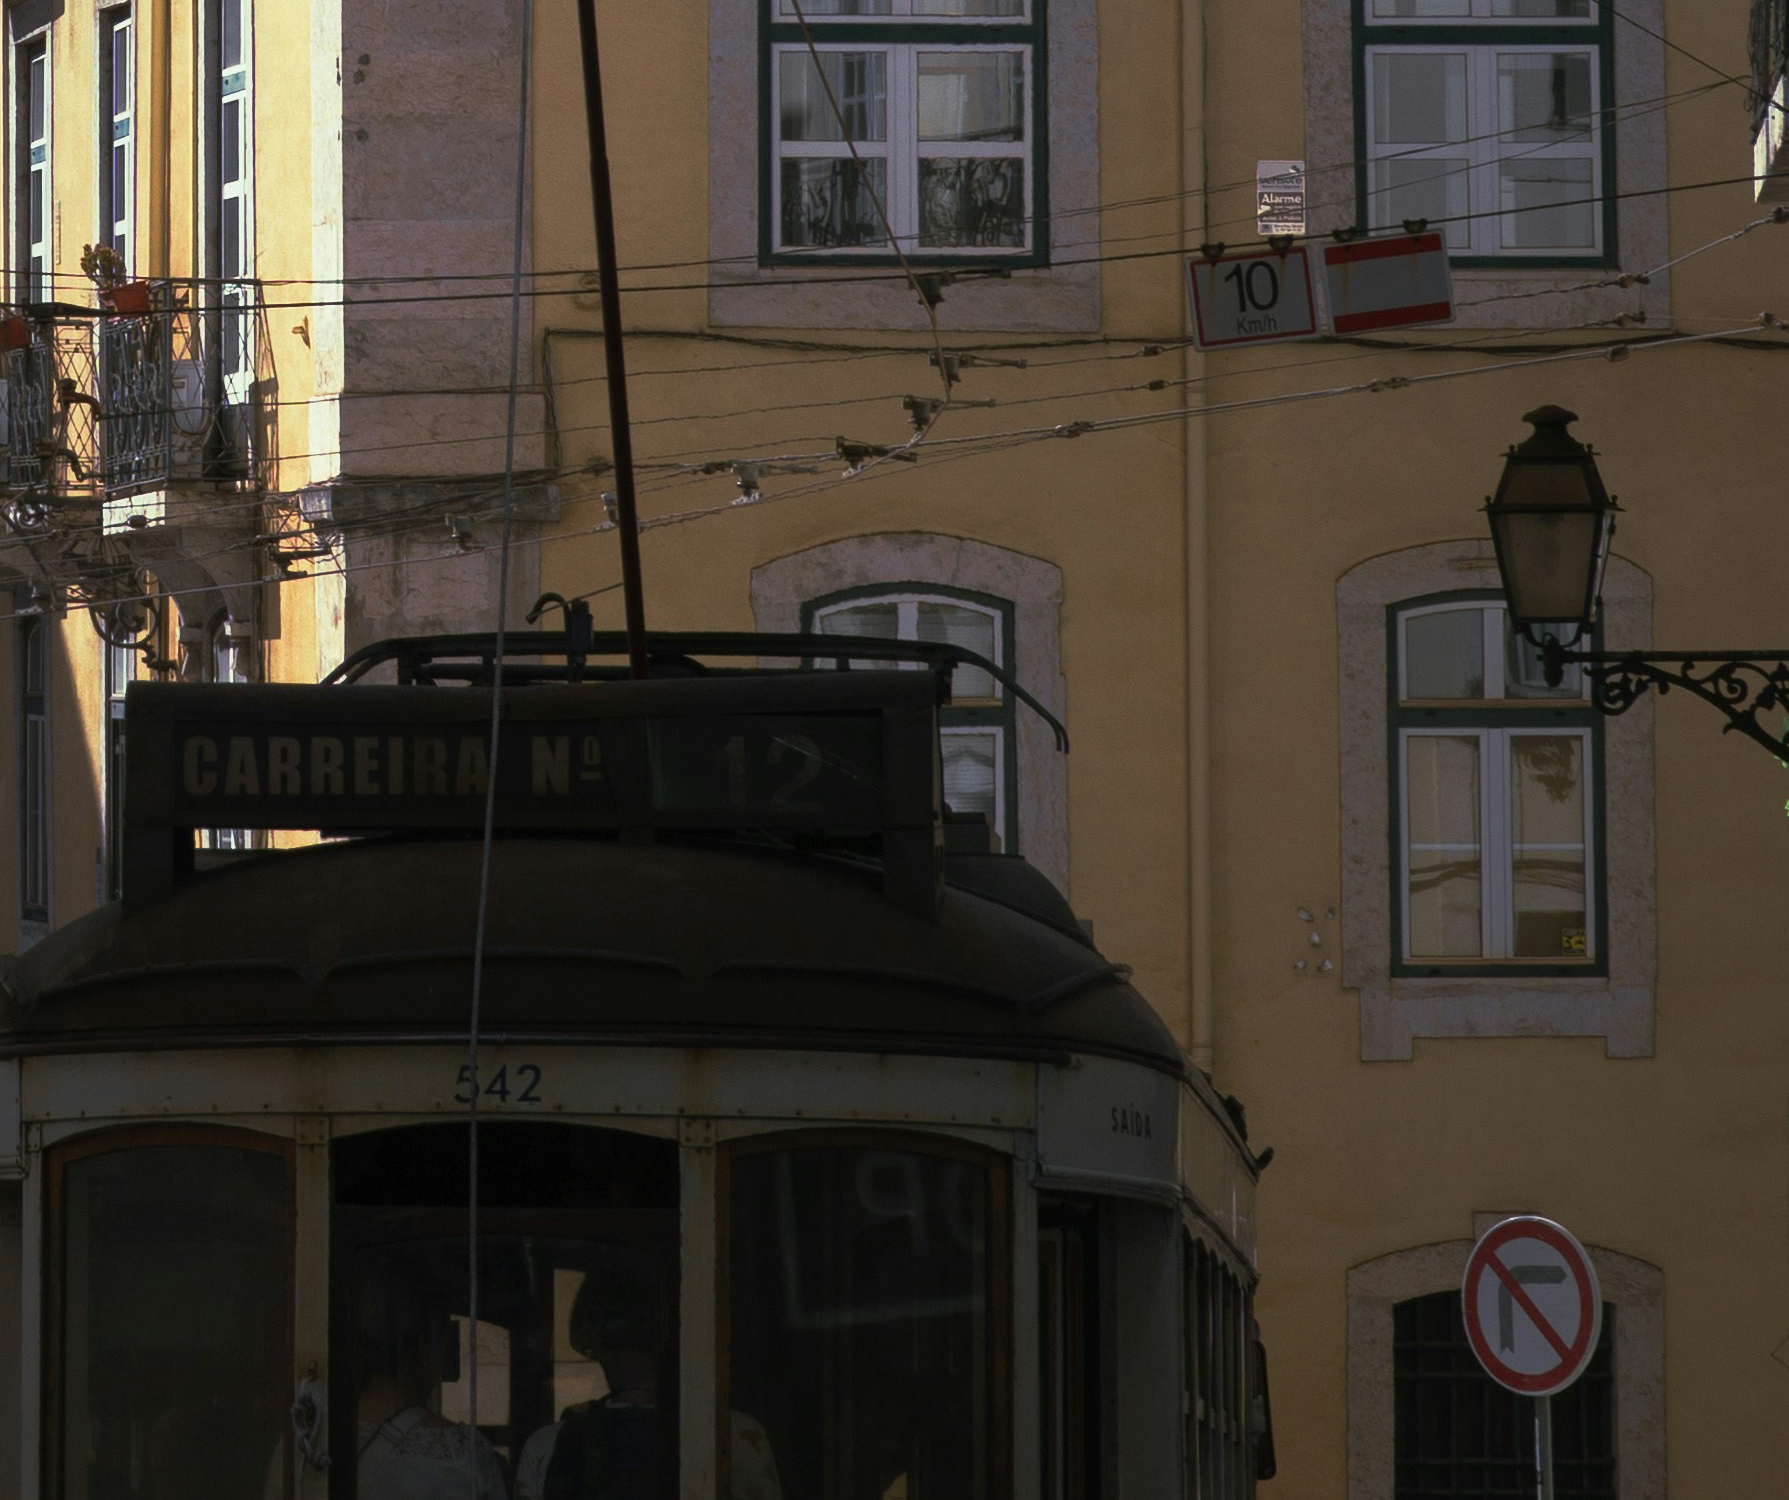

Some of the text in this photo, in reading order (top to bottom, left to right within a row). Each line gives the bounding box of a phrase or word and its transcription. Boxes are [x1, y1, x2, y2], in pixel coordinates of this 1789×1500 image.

[1261, 192, 1302, 204] Alarme
[1224, 260, 1279, 313] 10
[1236, 314, 1278, 335] Km/h
[182, 734, 489, 797] CARREIRA
[714, 735, 828, 815] 12
[453, 1063, 543, 1104] 542
[1111, 1102, 1153, 1140] SAÍDA
